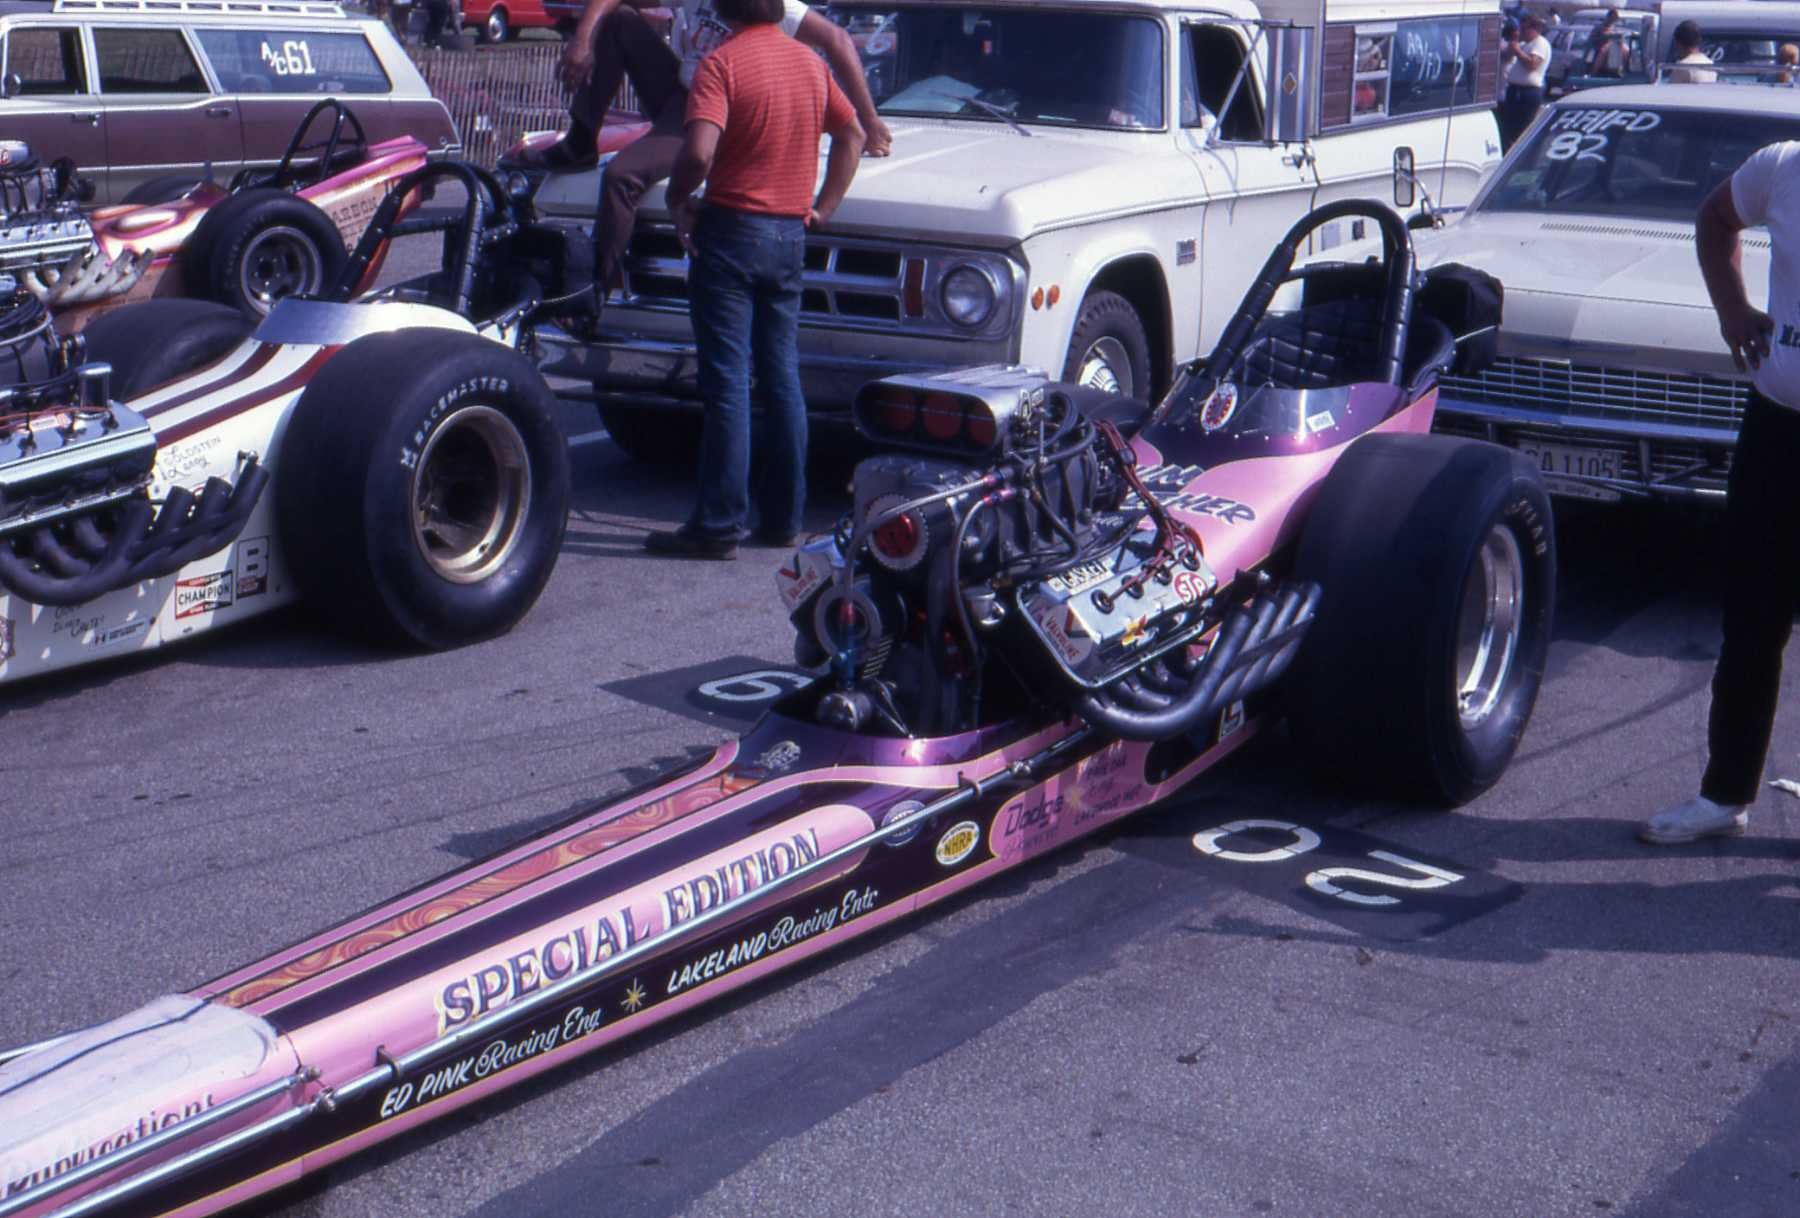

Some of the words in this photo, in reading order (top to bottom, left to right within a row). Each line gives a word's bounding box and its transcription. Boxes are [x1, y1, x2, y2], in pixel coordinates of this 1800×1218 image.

[283, 40, 316, 75] 61
[1546, 131, 1608, 161] 82
[178, 583, 230, 606] CHAMPION
[437, 906, 650, 1036] SPECIAL
[662, 828, 820, 931] EDITION
[381, 1083, 413, 1119] ED
[416, 1057, 475, 1103] PINK
[475, 1022, 561, 1078] Racing
[666, 932, 768, 994] LAKELAND
[767, 905, 838, 950] Racing
